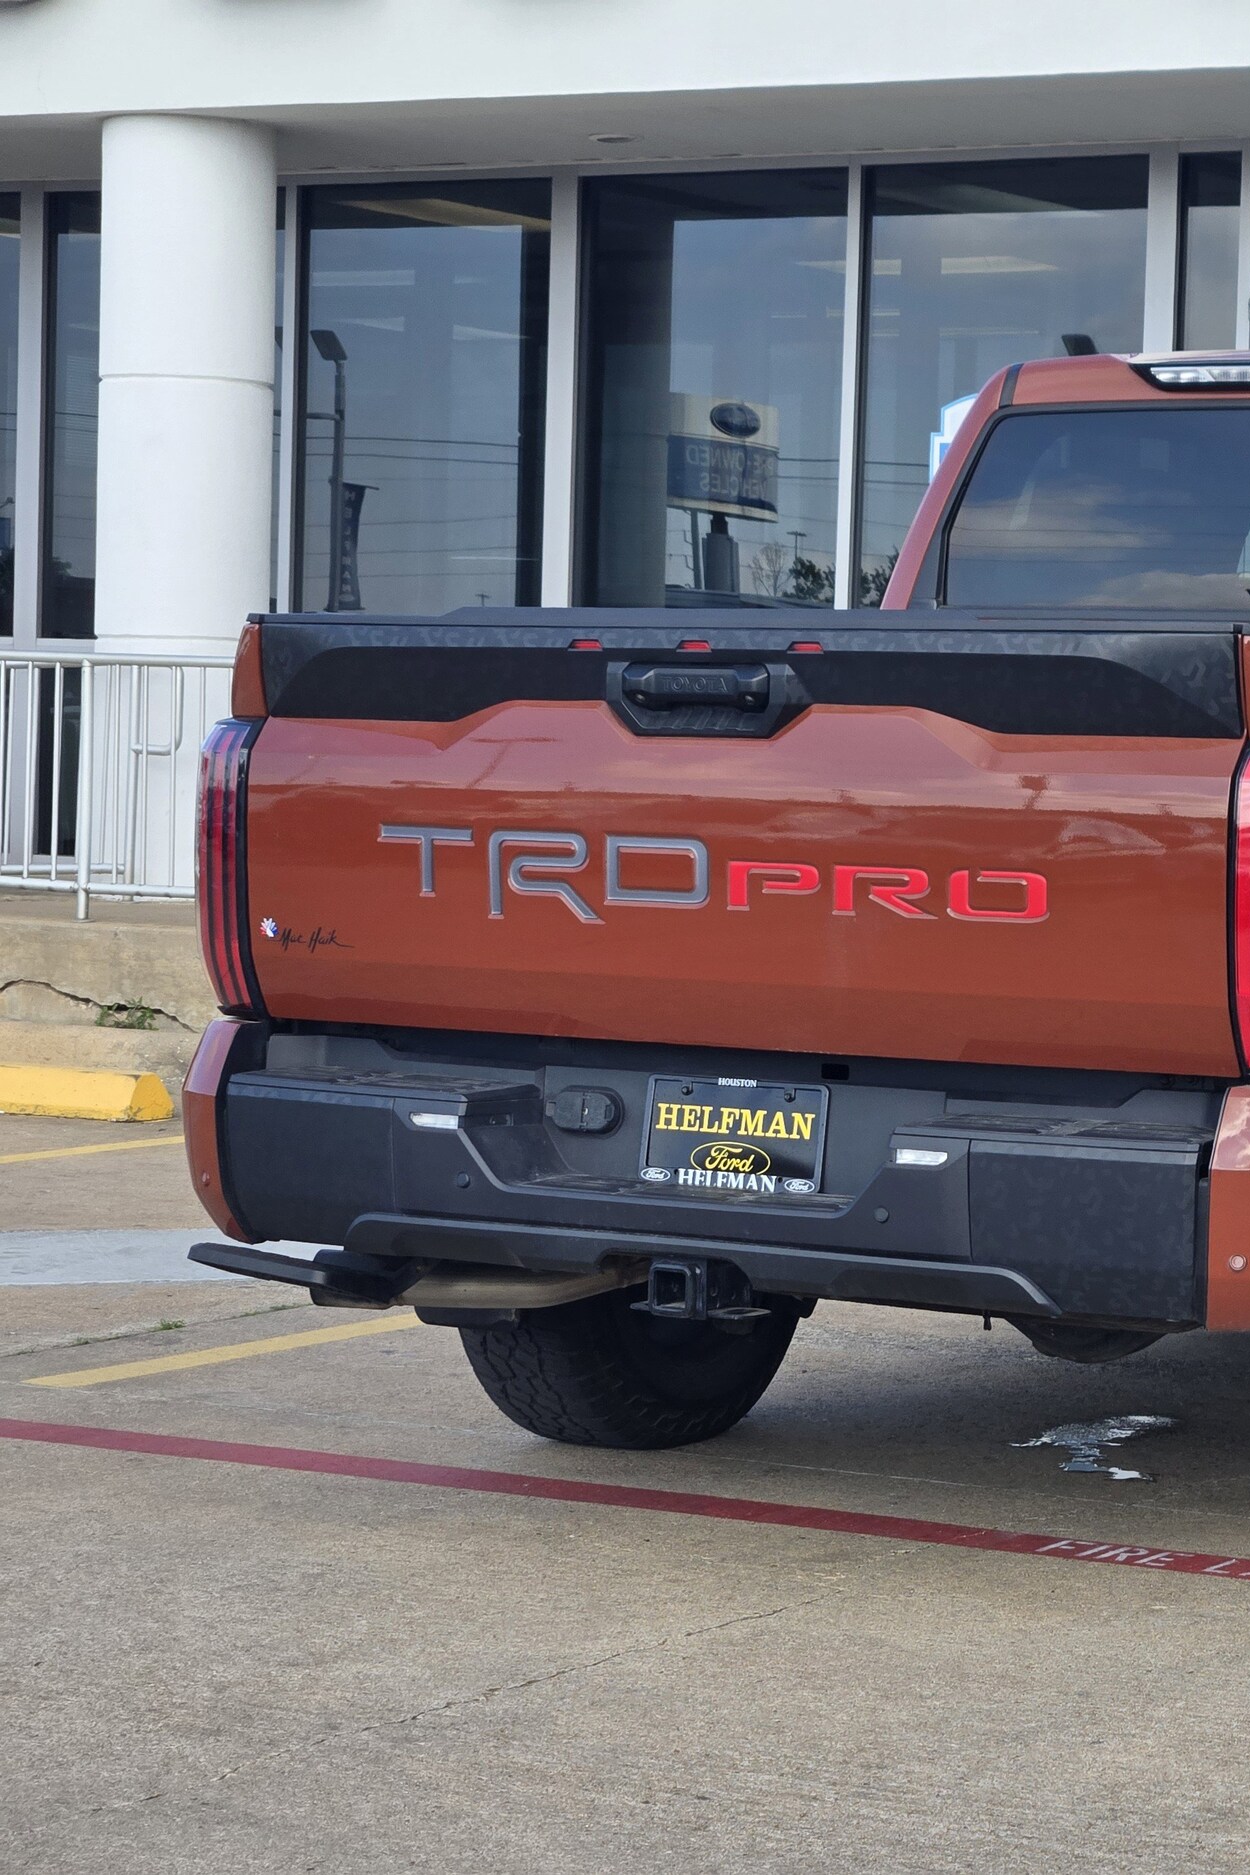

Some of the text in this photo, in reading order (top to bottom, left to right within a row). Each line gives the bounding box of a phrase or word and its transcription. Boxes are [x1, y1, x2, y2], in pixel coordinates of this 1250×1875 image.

[663, 676, 728, 692] TOYOTA
[378, 823, 1050, 924] TRD PRO
[718, 1077, 757, 1088] HOUSTON
[655, 1102, 815, 1140] HELFMAN
[705, 1144, 754, 1173] Ford
[678, 1168, 777, 1192] HELFMAN
[1034, 1539, 1195, 1567] FIRE
